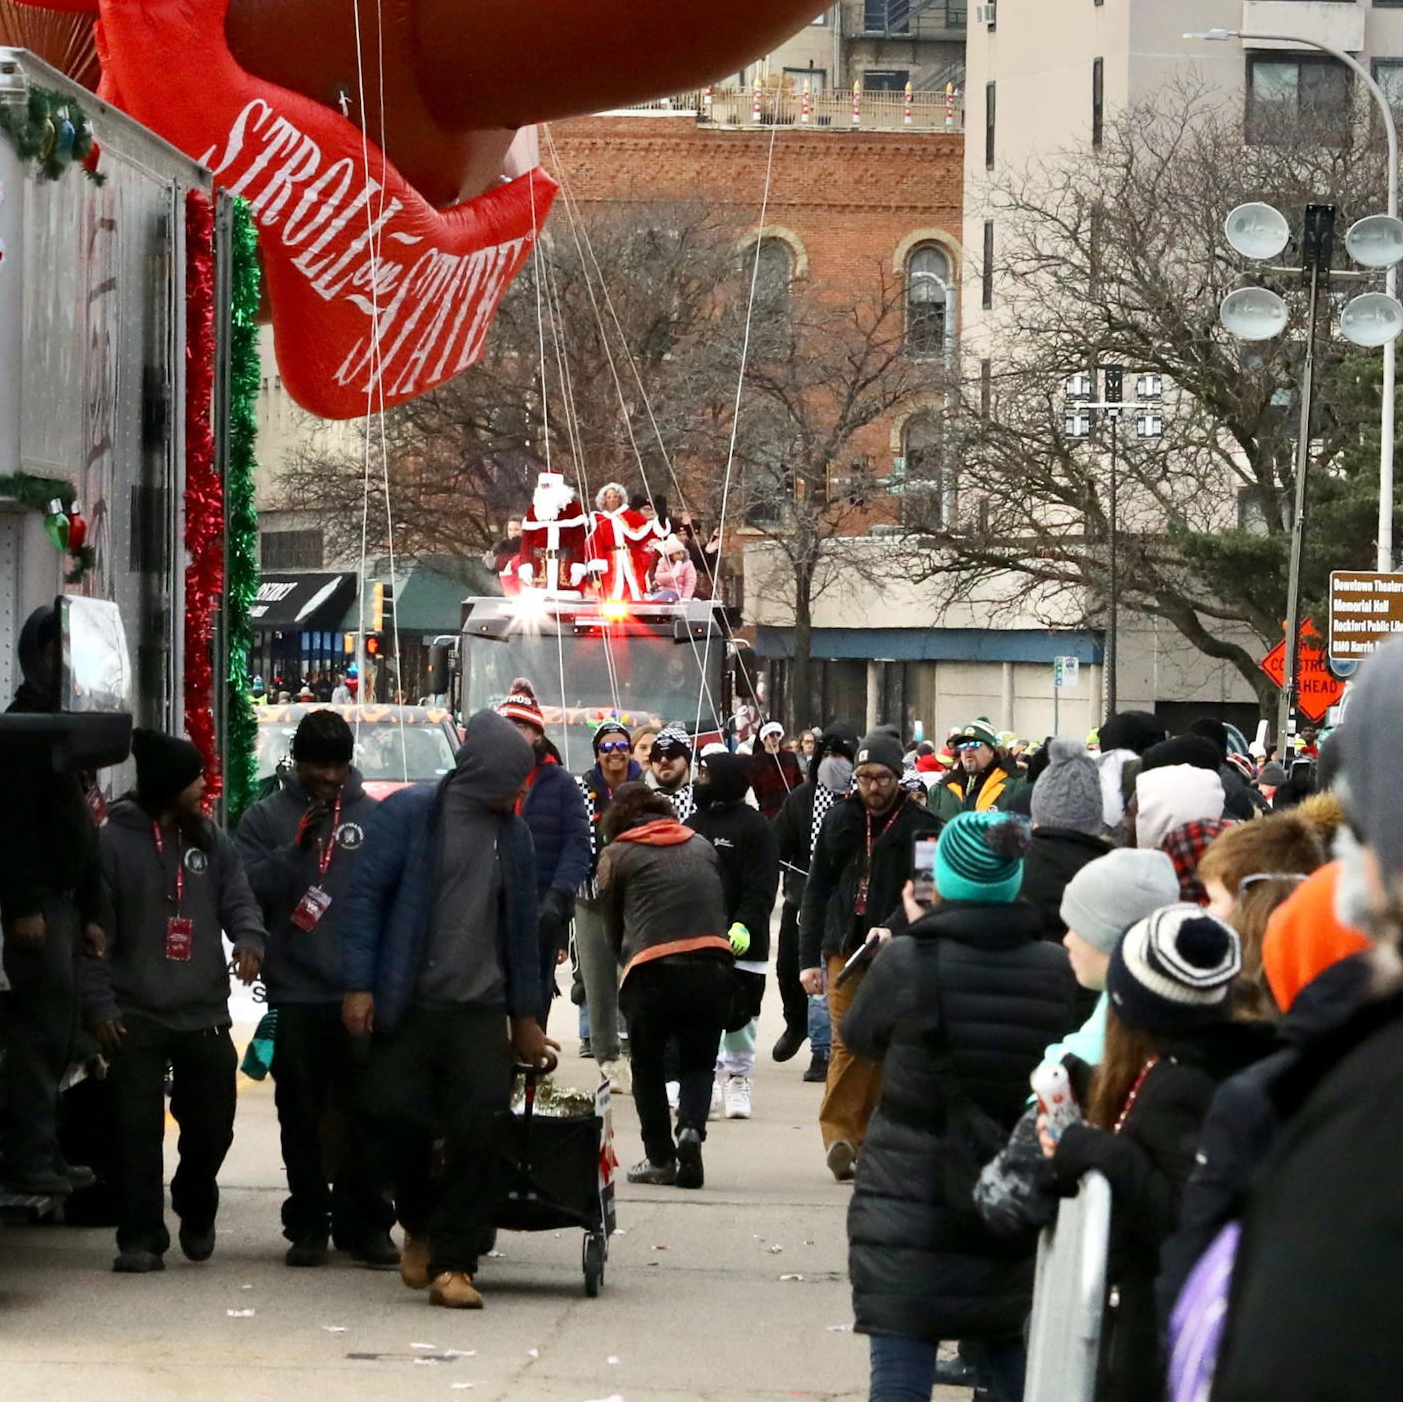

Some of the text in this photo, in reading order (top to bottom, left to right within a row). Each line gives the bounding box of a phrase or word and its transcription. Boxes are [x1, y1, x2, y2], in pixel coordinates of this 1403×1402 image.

[200, 98, 403, 301] STROLL
[352, 256, 403, 296] on
[333, 237, 525, 396] STATE
[1333, 578, 1373, 592] Downtown
[1333, 598, 1389, 613] Memorial Hall
[1333, 619, 1367, 632] Rockford
[1367, 619, 1390, 632] Public
[1333, 640, 1349, 652] BMO
[1350, 641, 1374, 653] Harris
